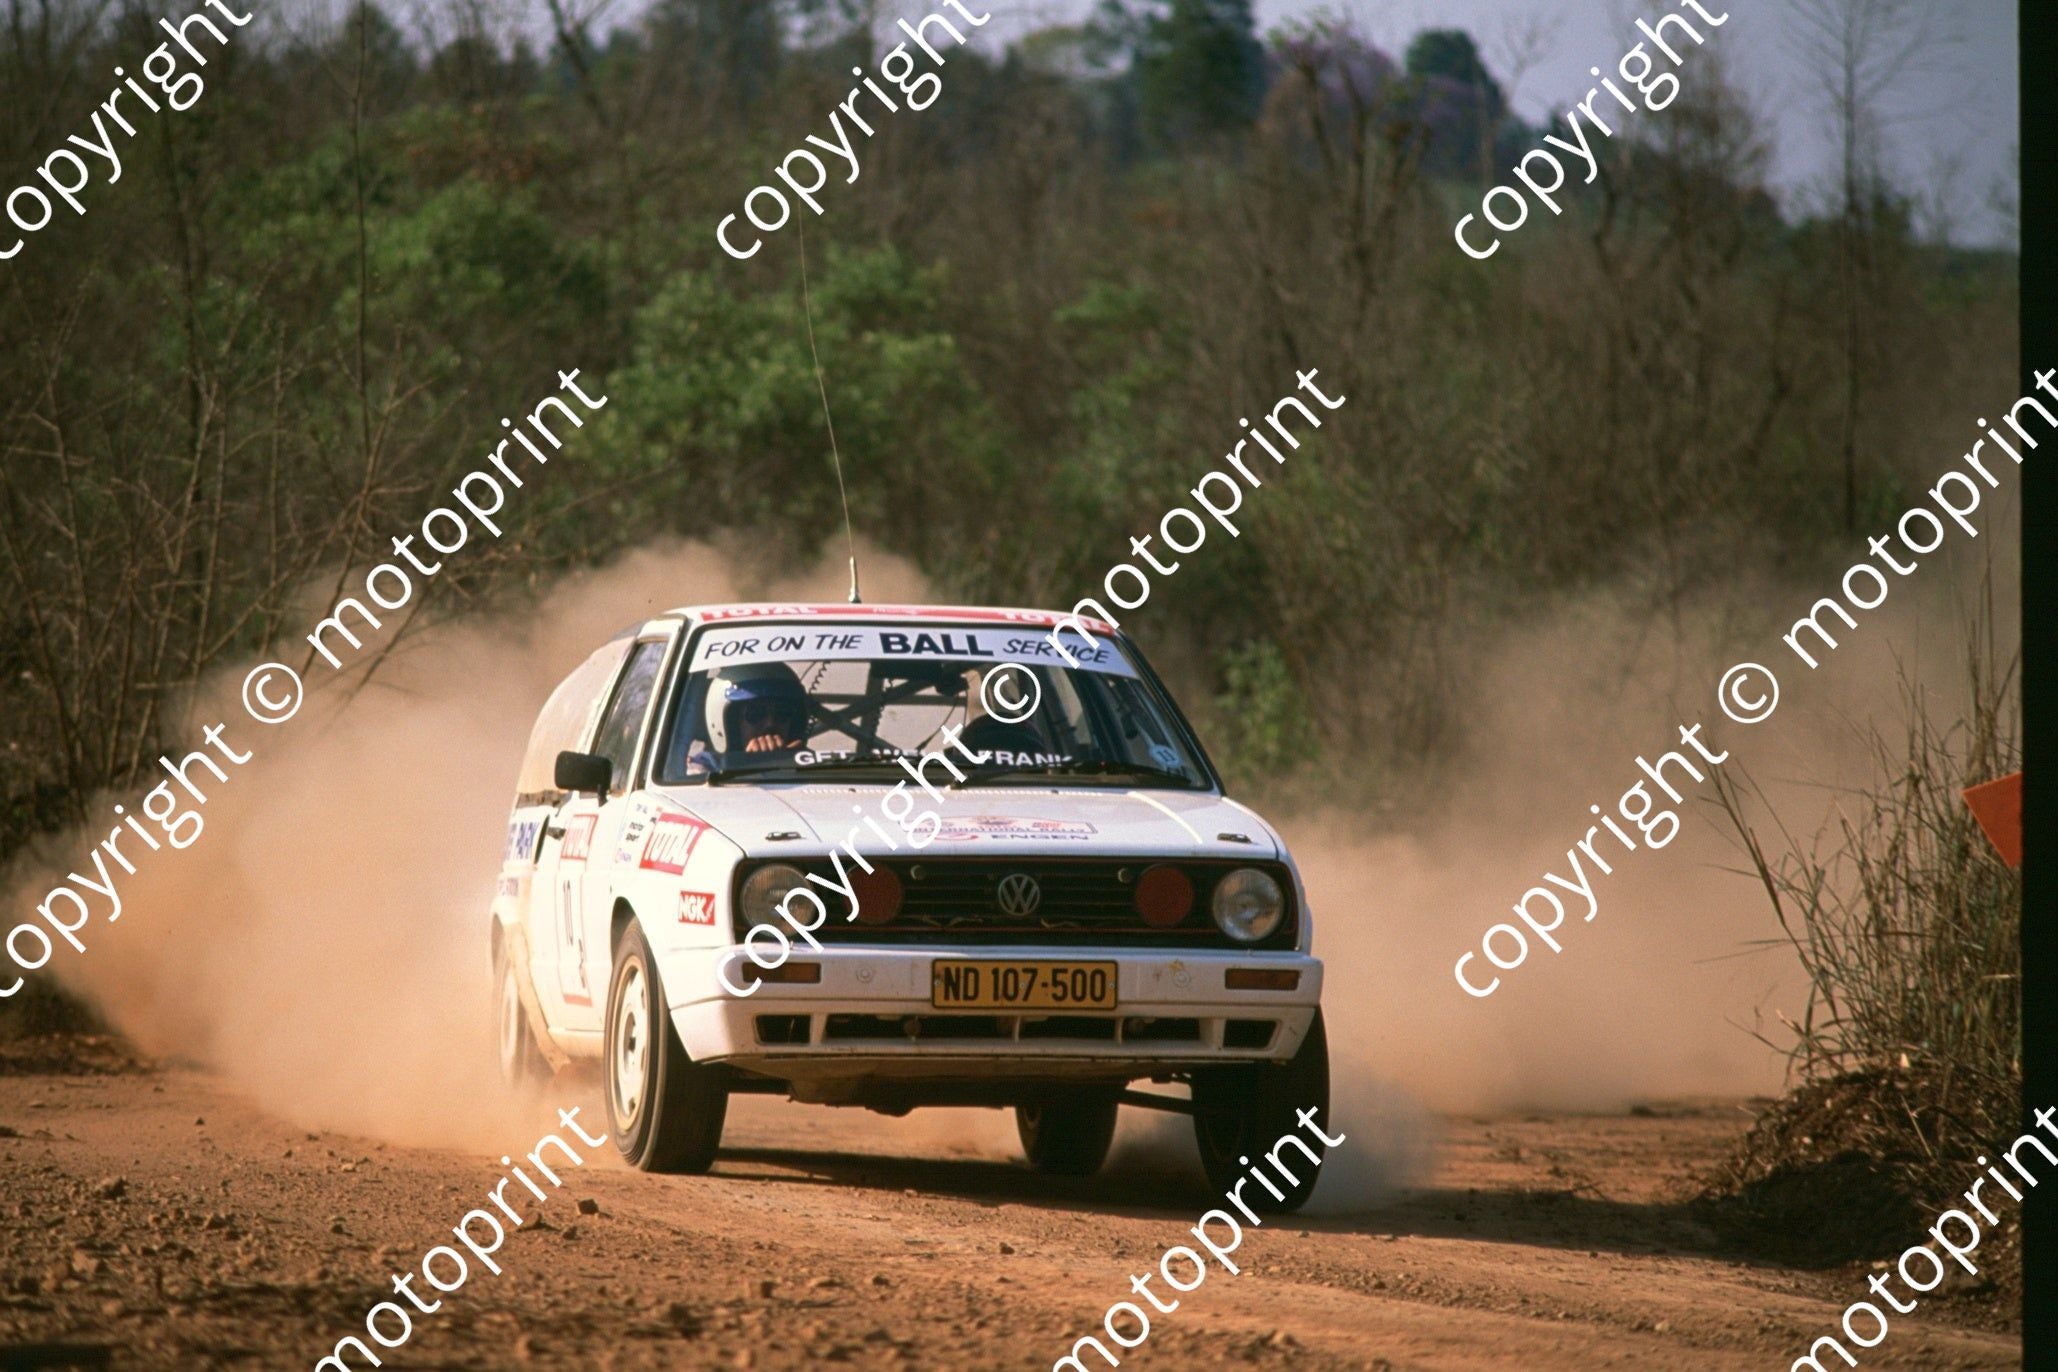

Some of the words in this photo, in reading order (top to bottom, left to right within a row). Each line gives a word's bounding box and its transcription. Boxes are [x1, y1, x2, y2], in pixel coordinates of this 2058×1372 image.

[706, 606, 818, 619] TOTAL
[704, 638, 761, 660] FOR
[767, 635, 806, 652] ON
[815, 633, 864, 650] THE
[879, 632, 994, 657] BALL
[1002, 637, 1110, 664] SERVICE
[643, 820, 700, 868] TOTAL
[679, 893, 708, 923] NGK
[943, 967, 980, 1001] ND
[991, 967, 1107, 1002] 107-500
